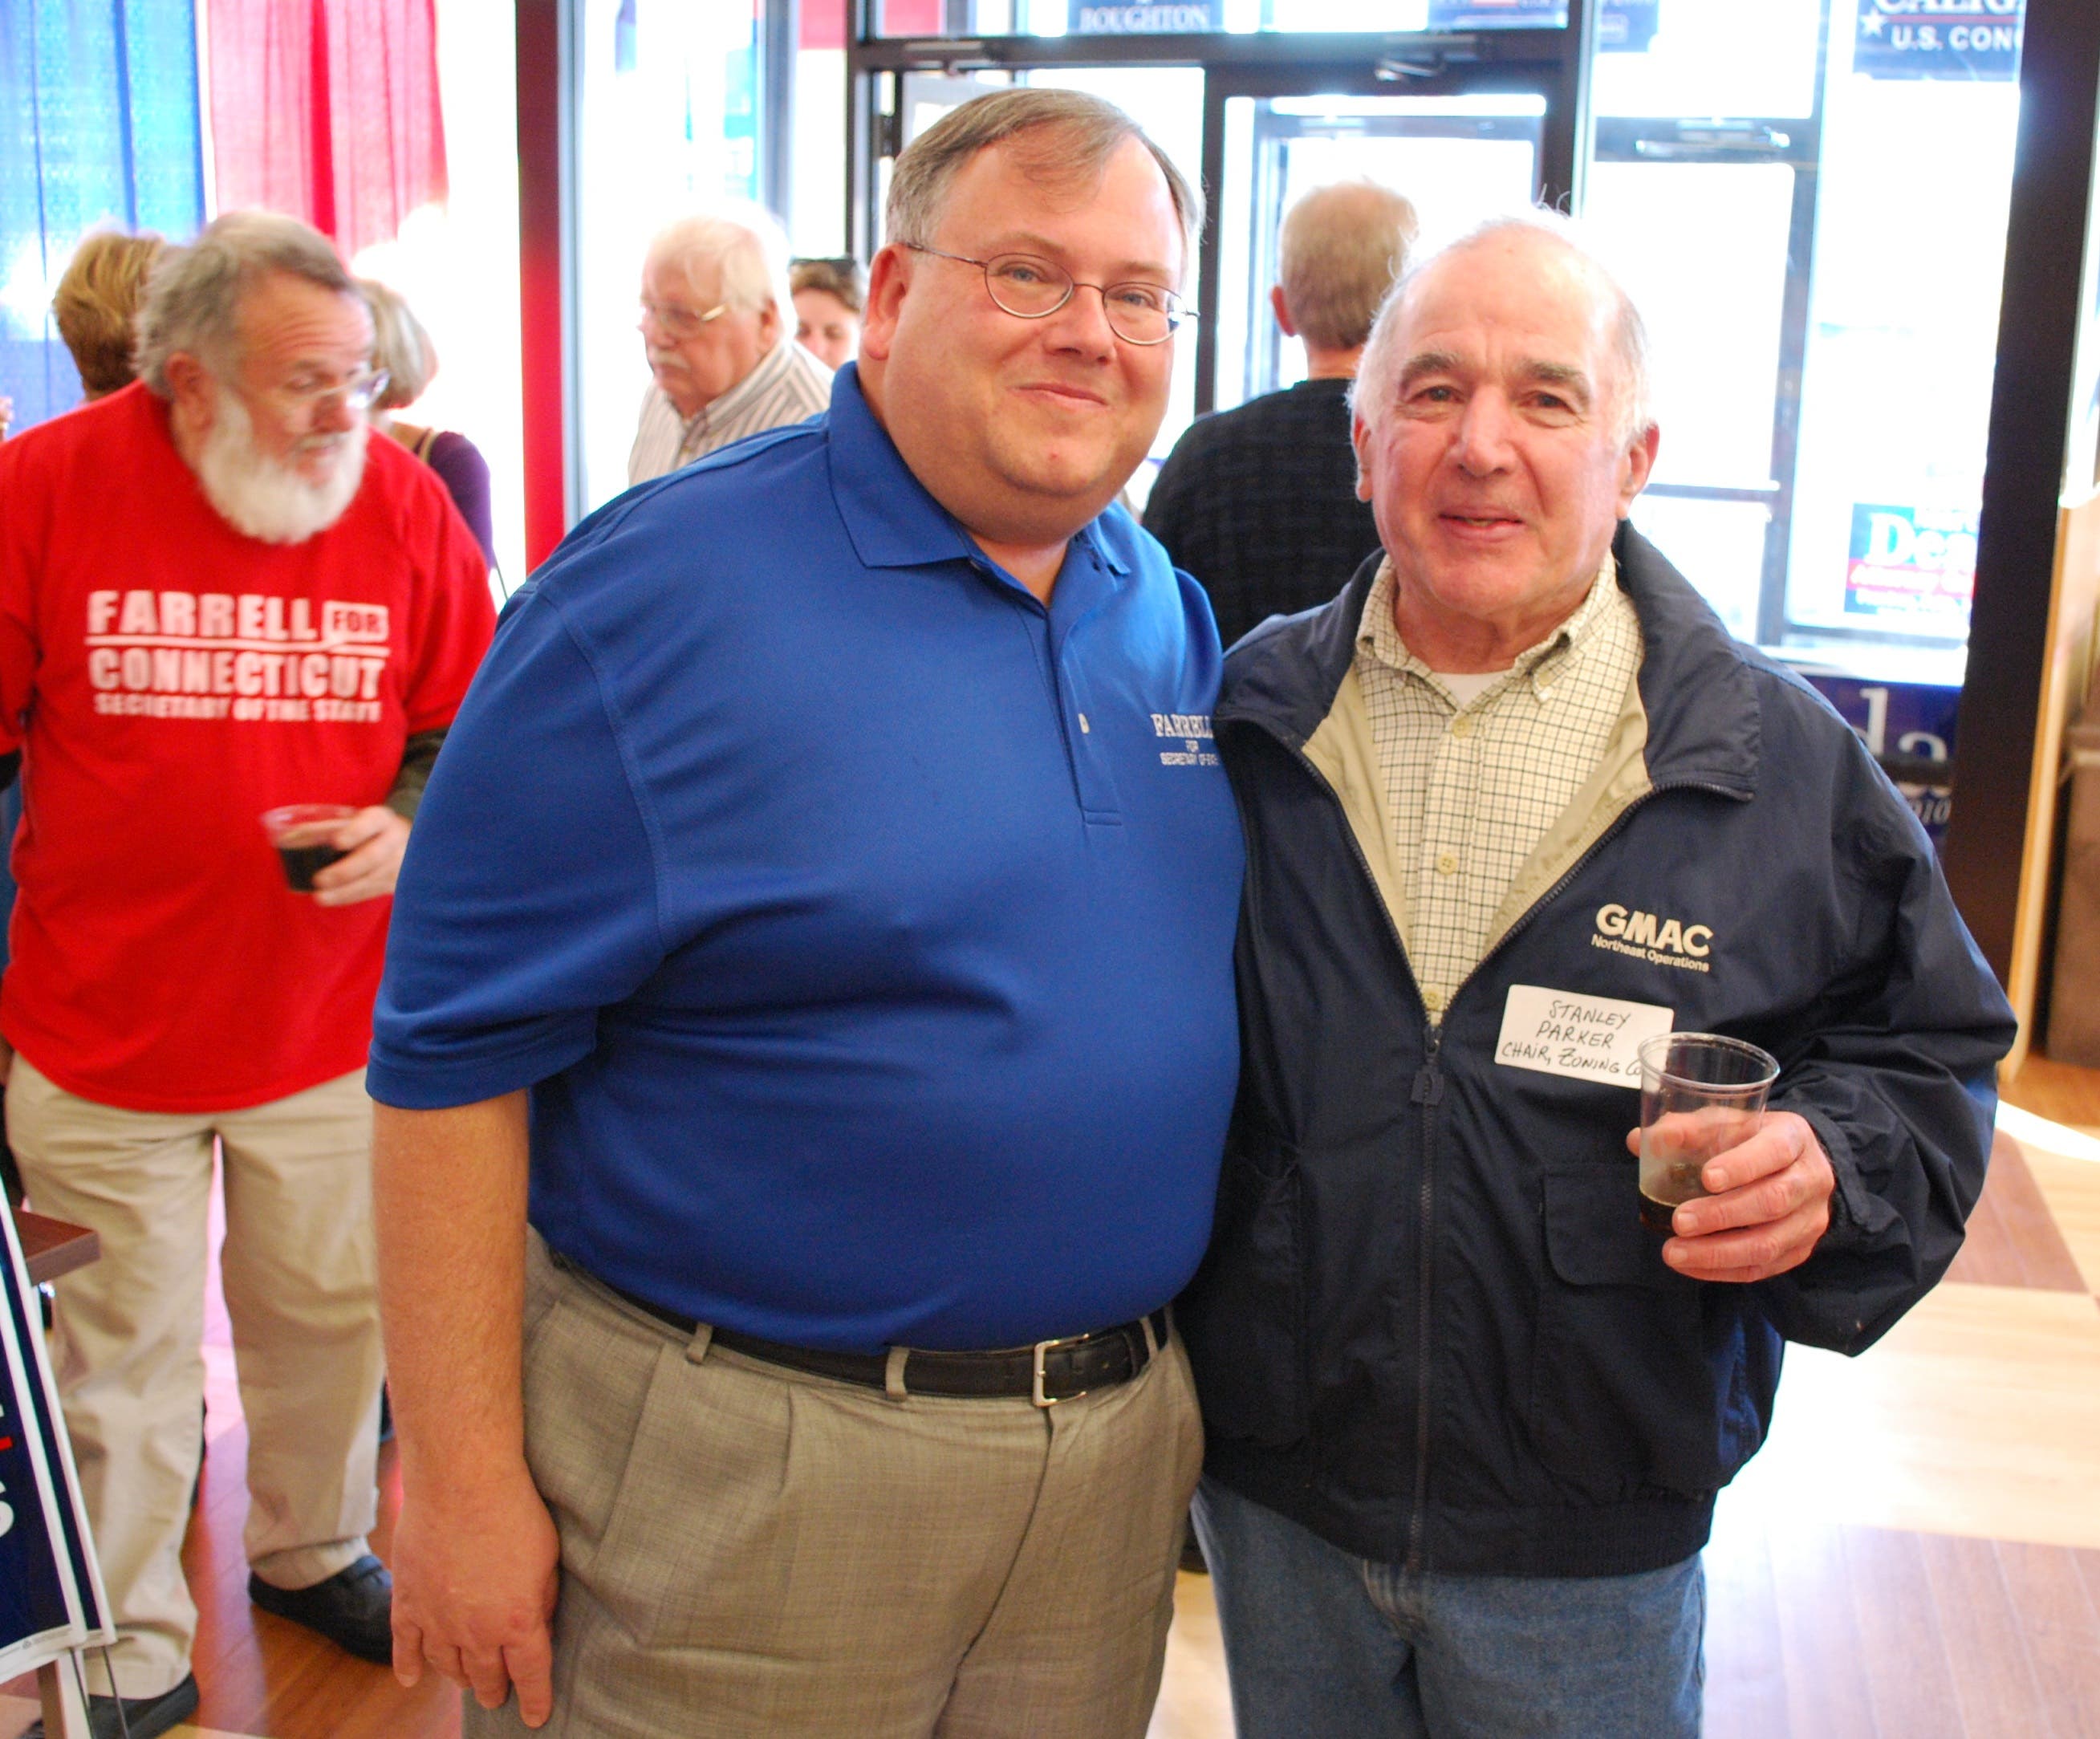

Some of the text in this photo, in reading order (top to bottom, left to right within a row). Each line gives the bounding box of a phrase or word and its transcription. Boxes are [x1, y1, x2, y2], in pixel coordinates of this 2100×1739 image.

[1079, 5, 1209, 34] BOUGHTON
[1891, 25, 2022, 51] U.S. CON
[87, 589, 381, 640] FARRELL FOR
[87, 648, 387, 699] CONNECTICUT
[1595, 903, 1714, 957] GMAC
[1590, 933, 1710, 973] Northeast Operations
[1548, 999, 1631, 1030] STANLEY
[1535, 1020, 1615, 1050] PARKER
[1558, 1047, 1621, 1074] ZONING
